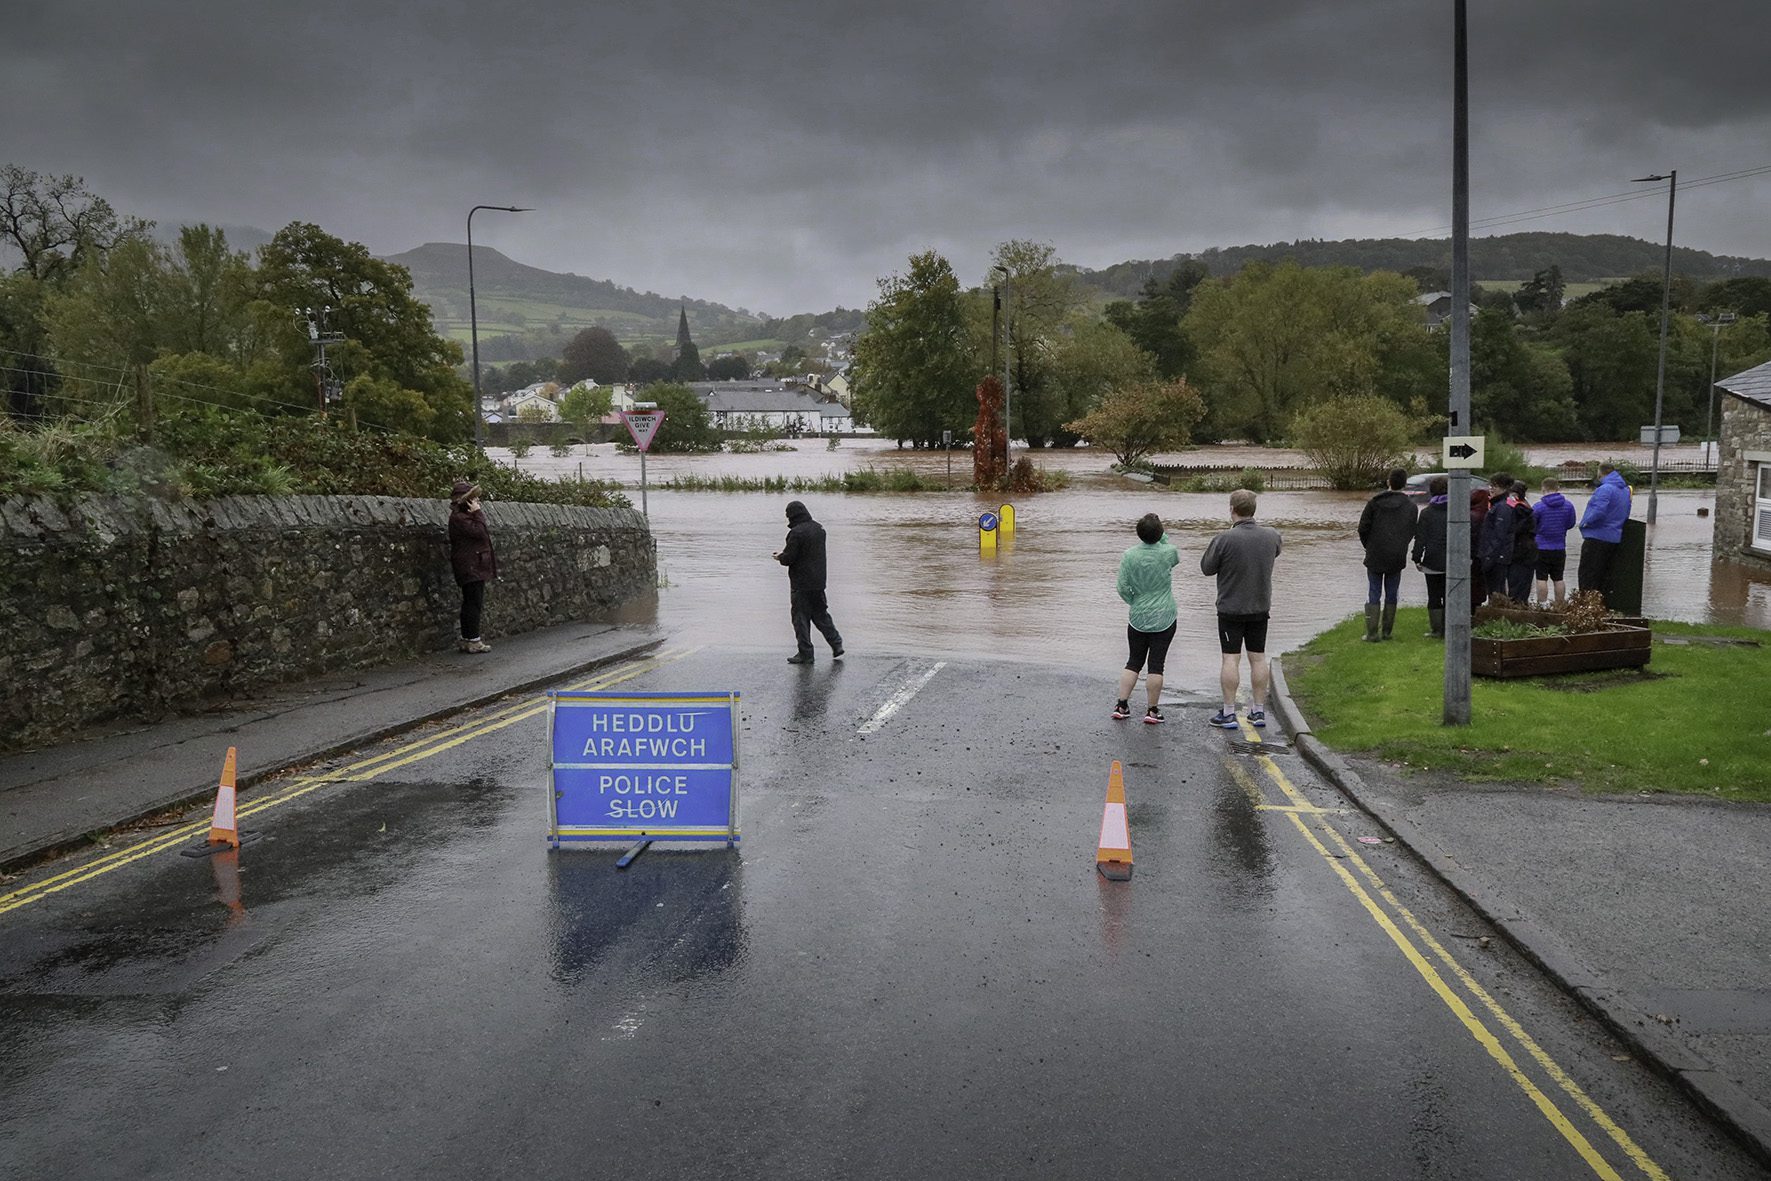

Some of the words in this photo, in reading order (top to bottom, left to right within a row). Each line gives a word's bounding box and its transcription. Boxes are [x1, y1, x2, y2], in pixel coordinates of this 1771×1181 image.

[592, 713, 695, 733] HEDDLU
[582, 737, 706, 757] ARAFWCH
[599, 775, 688, 795] POLICE
[609, 799, 679, 819] SLOW
